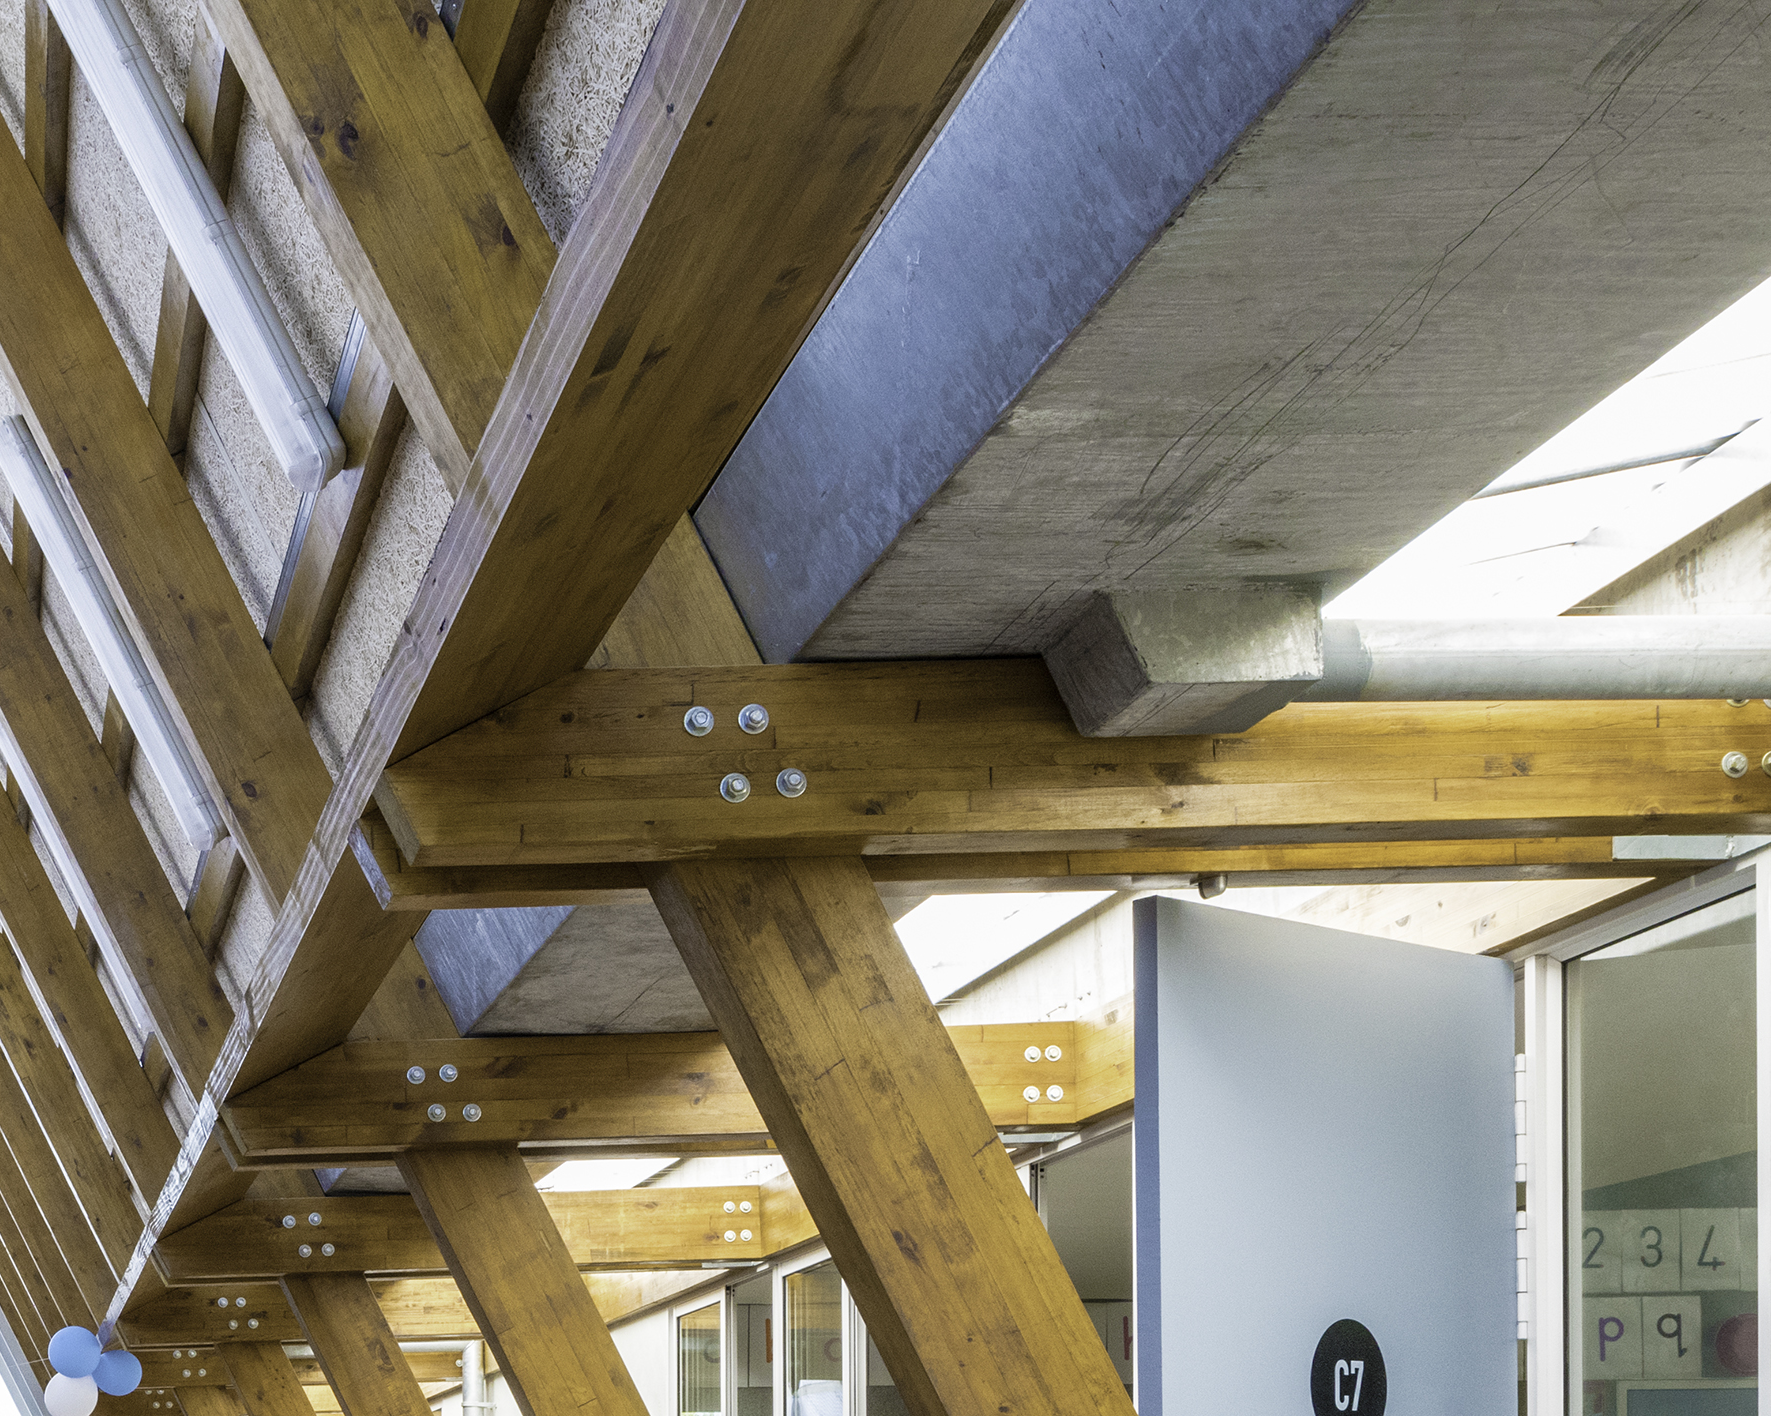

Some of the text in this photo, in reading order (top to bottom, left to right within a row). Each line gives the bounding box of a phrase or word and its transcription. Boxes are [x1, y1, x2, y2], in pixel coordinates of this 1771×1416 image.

[1582, 1224, 1726, 1272] 2 3 4
[1598, 1312, 1688, 1362] p q
[1334, 1359, 1364, 1411] C7
